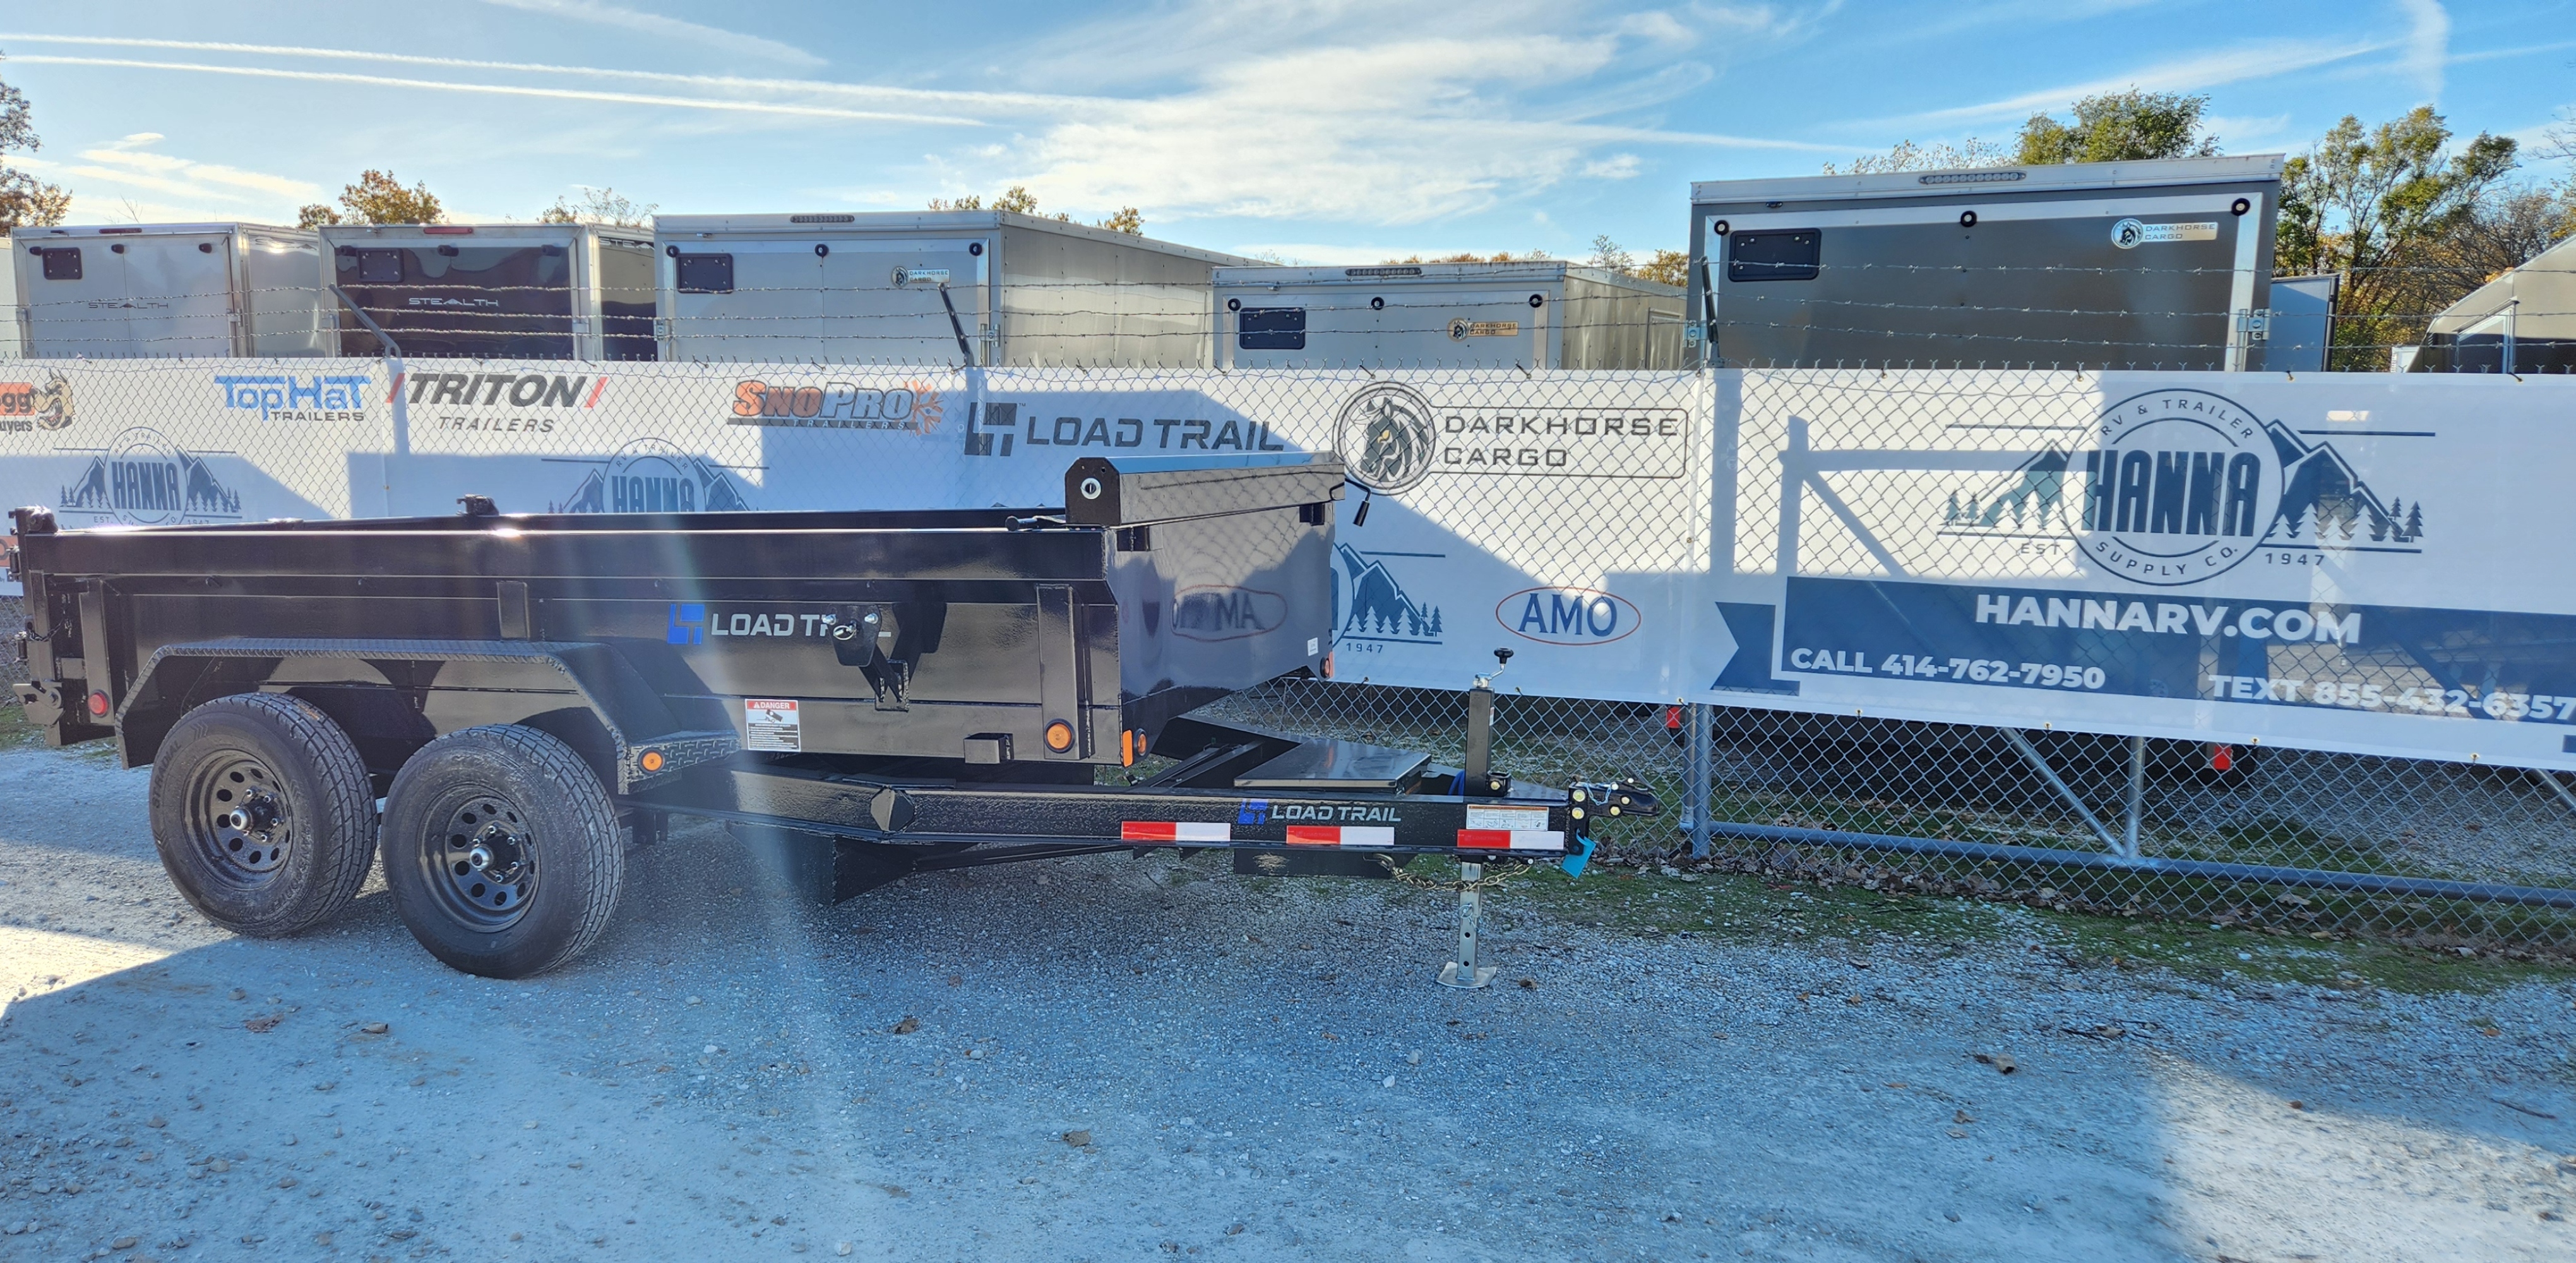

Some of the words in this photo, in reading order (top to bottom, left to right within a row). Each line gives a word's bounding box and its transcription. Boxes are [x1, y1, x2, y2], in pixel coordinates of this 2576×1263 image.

[2145, 224, 2215, 232] DARKHORSE
[408, 297, 499, 307] STEALTH
[408, 373, 588, 408] TRITON
[271, 412, 365, 422] TRAILERS
[438, 416, 555, 433] TRAILERS
[792, 419, 906, 430] TRAILERS
[1445, 416, 1679, 436] DARKHORSE
[2100, 414, 2124, 436] RV
[2137, 404, 2149, 415] &
[2162, 401, 2254, 439] TRAILER
[1027, 416, 1144, 447] LOAD
[1153, 419, 1284, 451] TRAIL
[643, 444, 689, 470] TRAILER
[1443, 446, 1567, 467] CARGO
[111, 461, 182, 511] HANNA
[611, 475, 695, 513] HANNA
[2080, 449, 2262, 537] HANNA
[2096, 541, 2187, 577] SUPPLY
[2204, 545, 2238, 567] CO.
[2265, 553, 2325, 566] 1947
[711, 613, 795, 637] LOAD
[1517, 592, 1618, 637] AMO
[1975, 594, 2362, 644] HANNARV.COM
[1346, 642, 1384, 654] 1947
[1790, 647, 1873, 674] CALL
[1881, 654, 2106, 690] 414-762-7950
[760, 702, 790, 710] DANGER
[2209, 674, 2306, 702] TEXT
[2313, 681, 2576, 721] 855-432-6357
[1271, 805, 1335, 821] LOAD
[1337, 806, 1402, 822] TRAIL
